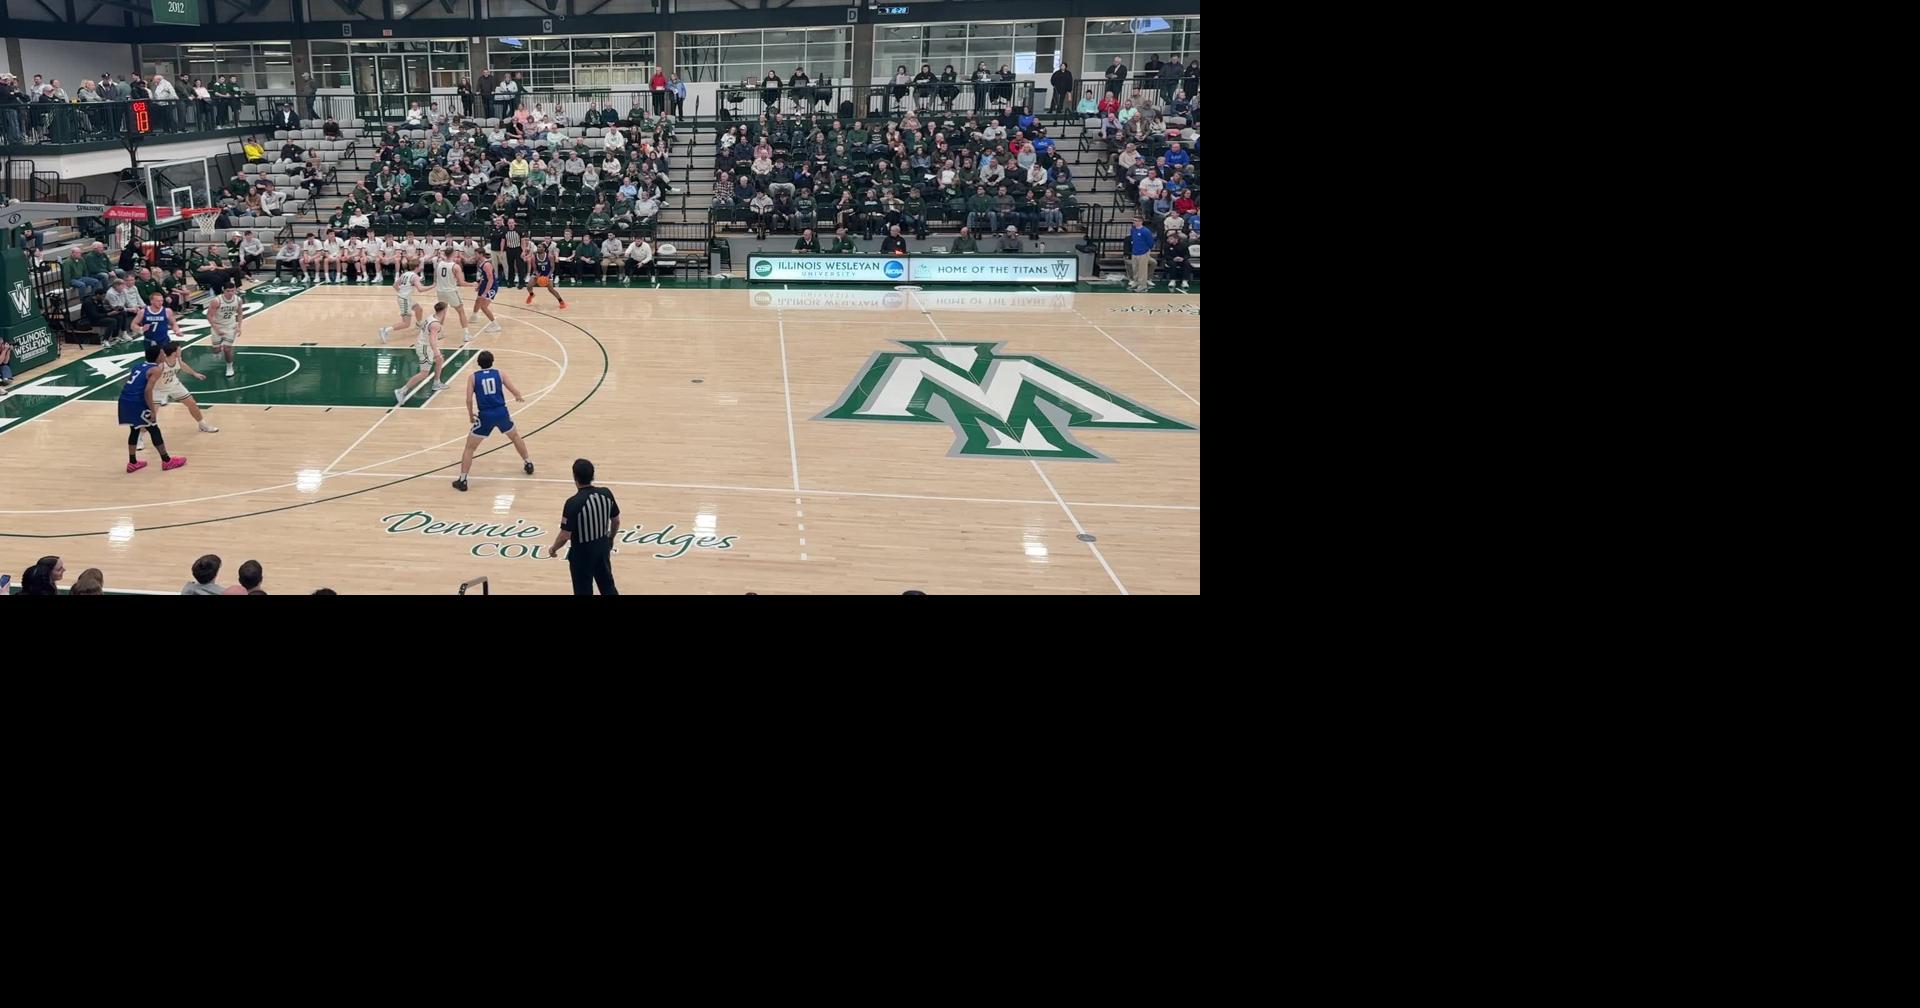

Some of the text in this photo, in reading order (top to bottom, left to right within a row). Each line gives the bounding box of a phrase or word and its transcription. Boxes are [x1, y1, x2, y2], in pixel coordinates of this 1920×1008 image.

[168, 1, 184, 13] 2012
[441, 267, 448, 277] 0
[778, 262, 880, 270] ILLINOIS WESLEYAN
[990, 266, 1008, 274] THE
[1013, 266, 1048, 274] TITANS
[151, 321, 158, 332] 7
[14, 336, 51, 356] WESLEYAN
[127, 370, 141, 384] 3
[481, 377, 496, 395] 10
[381, 509, 739, 560] Dennie idges
